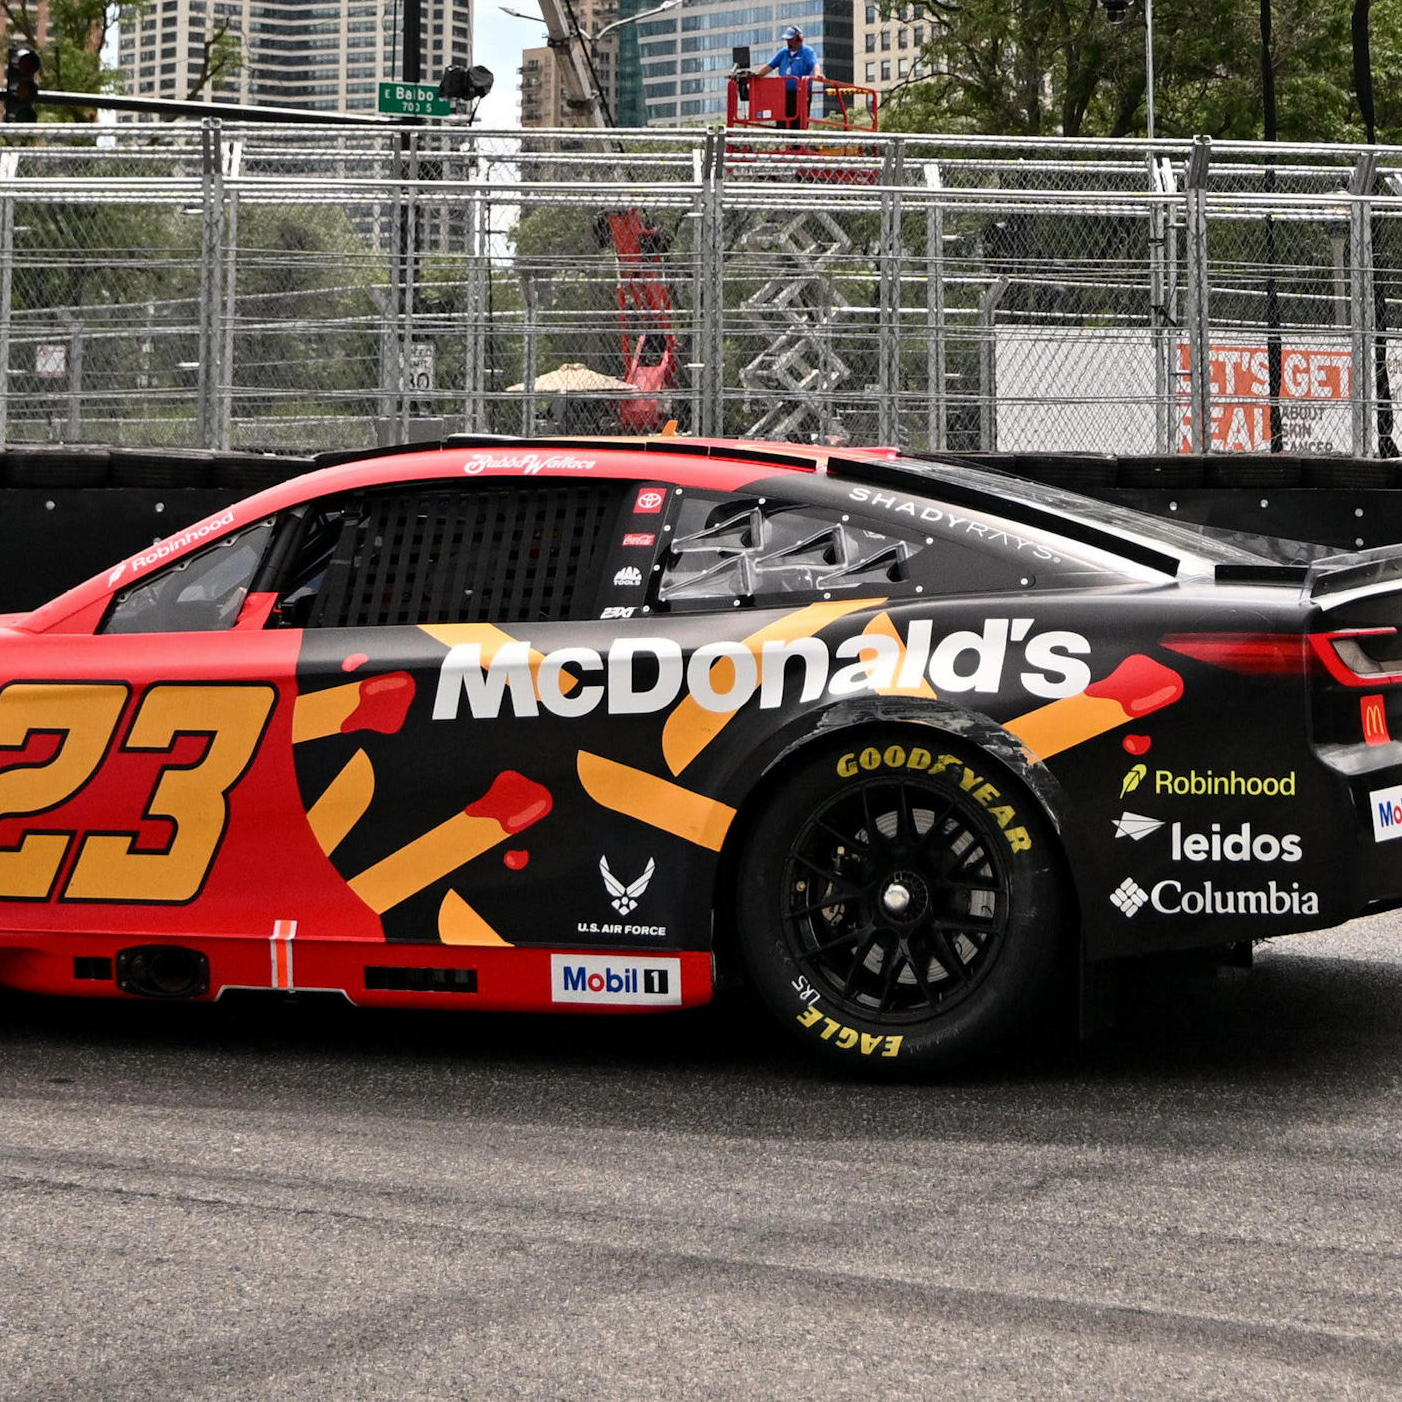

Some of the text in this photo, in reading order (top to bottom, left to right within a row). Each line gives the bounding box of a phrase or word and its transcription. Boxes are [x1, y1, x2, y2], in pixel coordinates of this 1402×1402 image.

[384, 89, 391, 99] E
[426, 102, 433, 113] S
[1284, 354, 1352, 398] GET
[523, 454, 596, 474] Wallace
[131, 511, 234, 572] Robinhood
[432, 618, 1092, 721] McDonald's
[837, 745, 1032, 854] GOODYEAR
[1155, 770, 1296, 796] Robinhood
[1171, 821, 1303, 862] leidos
[1150, 879, 1320, 915] Columbia
[578, 923, 666, 936] U.S. AIR FORCE
[563, 965, 637, 993] Mobil
[796, 1005, 904, 1057] EAGLE
